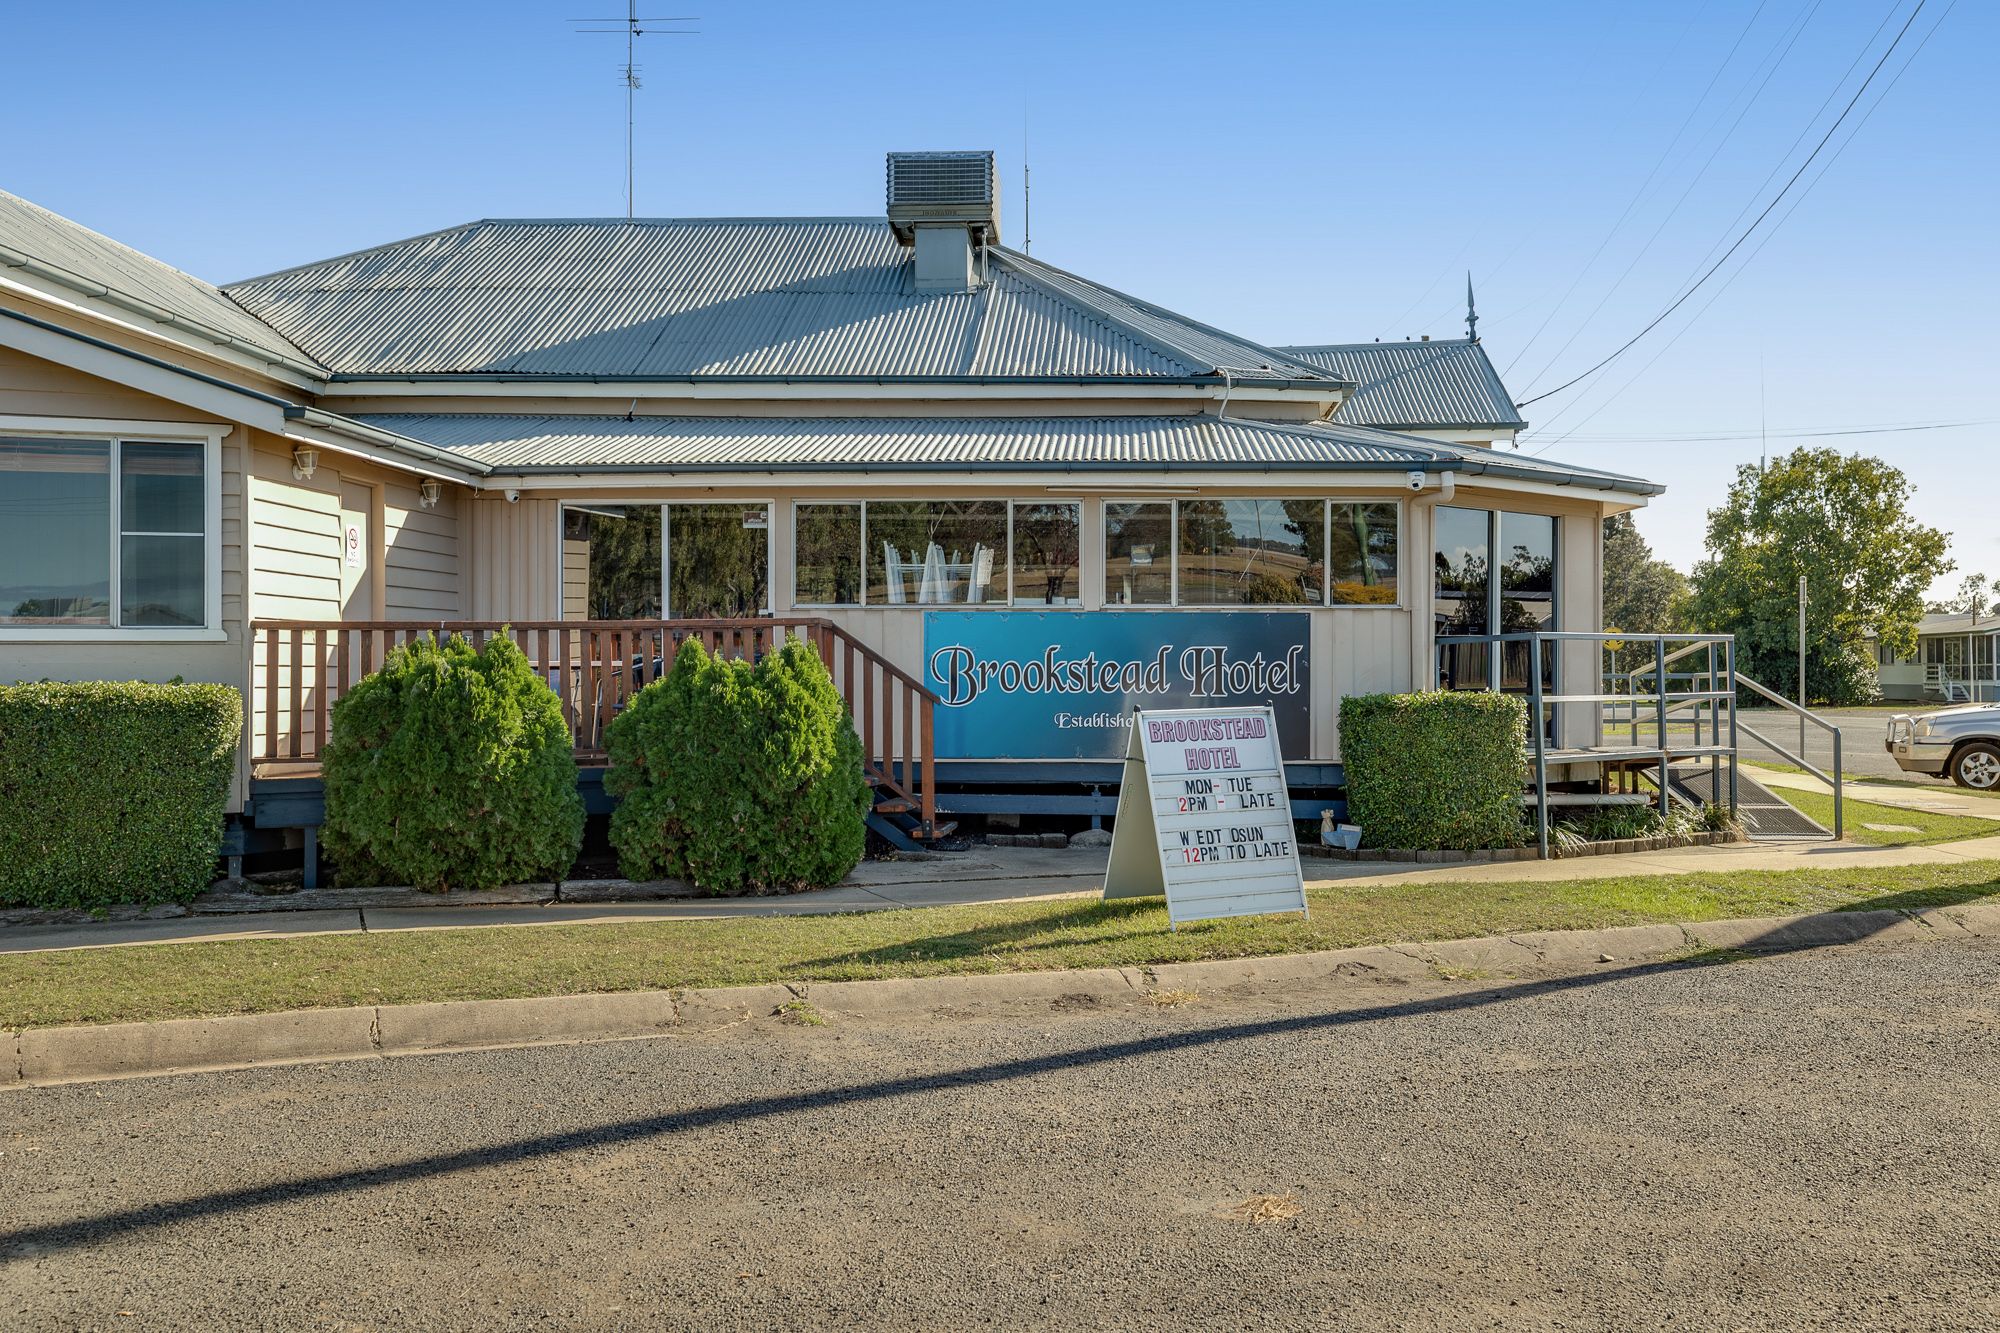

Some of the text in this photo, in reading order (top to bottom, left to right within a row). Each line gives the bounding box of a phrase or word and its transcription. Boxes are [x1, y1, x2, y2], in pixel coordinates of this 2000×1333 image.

[931, 643, 1303, 707] Brookstead Hotel
[1148, 717, 1267, 743] BROOKSTEAD
[1185, 747, 1240, 771] HOTEL
[1228, 777, 1253, 792] TUE
[1179, 797, 1208, 812] 2PM
[1240, 793, 1275, 808] LATE
[1183, 841, 1289, 863] 12PM TO LATE
